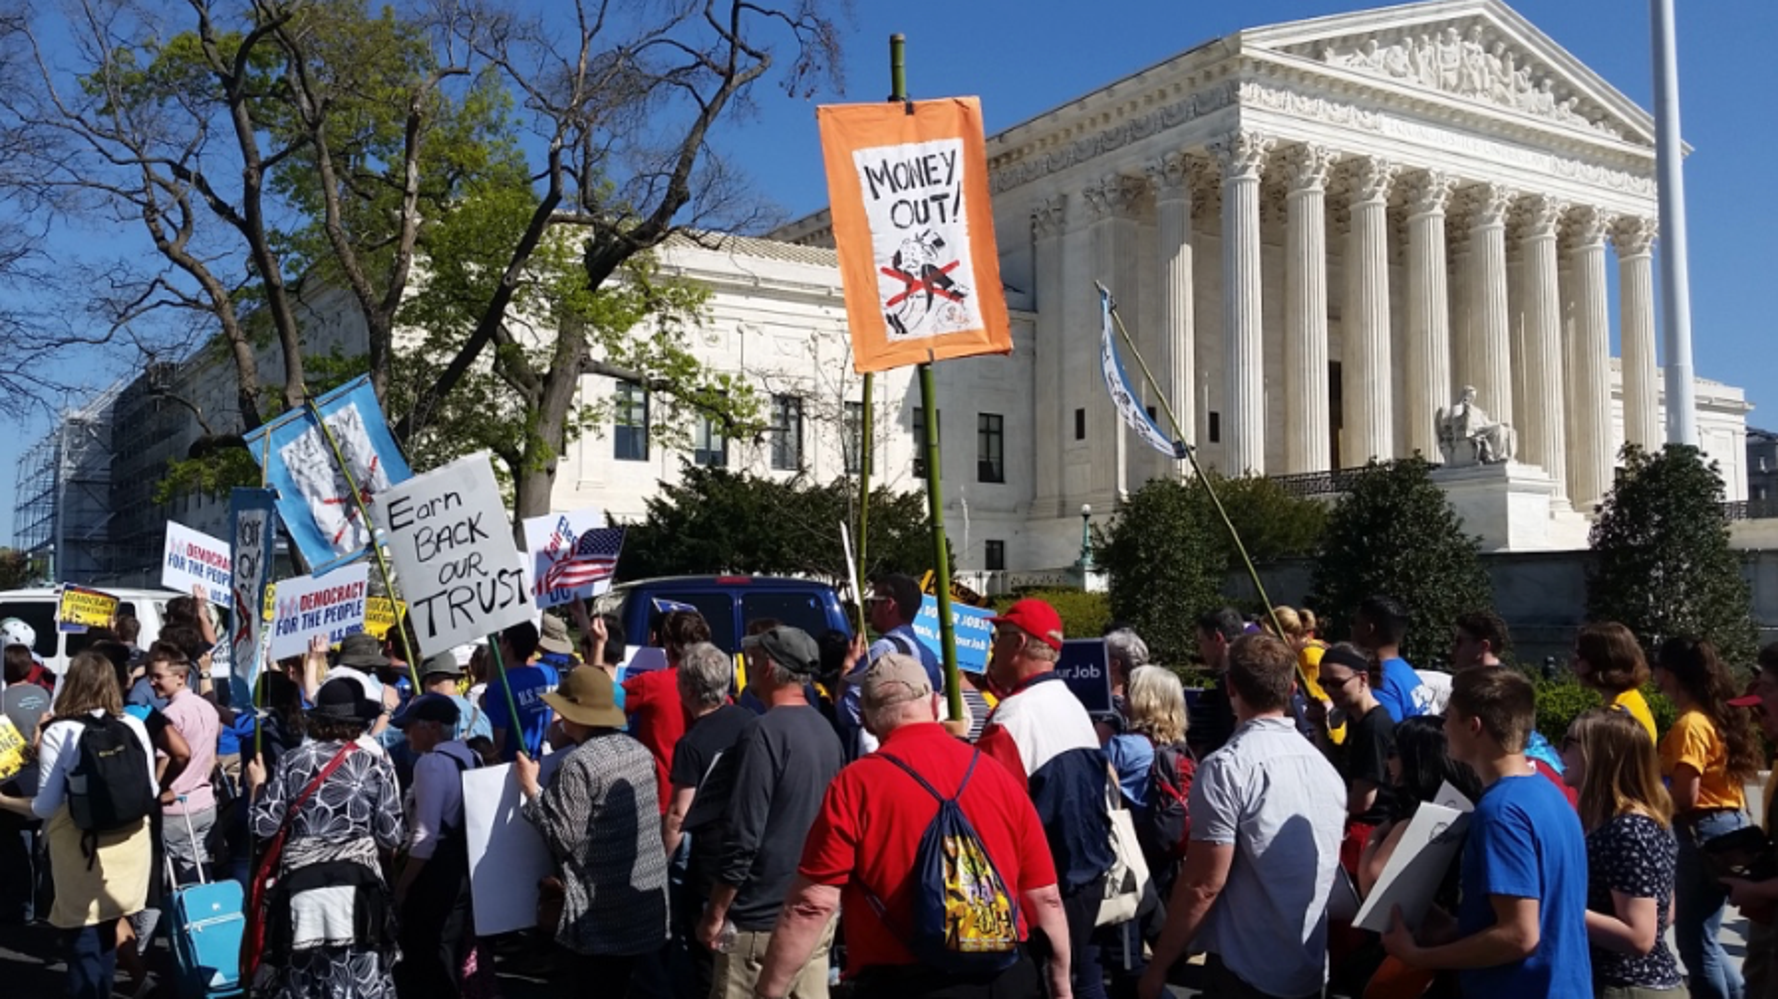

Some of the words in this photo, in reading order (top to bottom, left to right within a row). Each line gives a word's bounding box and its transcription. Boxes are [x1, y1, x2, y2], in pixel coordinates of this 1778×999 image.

[864, 149, 956, 200] MONEY
[890, 181, 961, 229] OUT!
[387, 491, 462, 532] Earn
[413, 511, 489, 563] BACK
[168, 552, 185, 572] FOR
[188, 560, 203, 578] THE
[206, 565, 231, 588] PEOP
[186, 542, 231, 571] DEMOCRA
[438, 552, 488, 585] OUR
[300, 580, 365, 612] DEMOCRACY
[413, 568, 528, 639] TRUST
[276, 617, 298, 637] FOR
[302, 610, 321, 630] THE
[324, 600, 363, 625] PEOPLE
[1056, 663, 1101, 679] urJob
